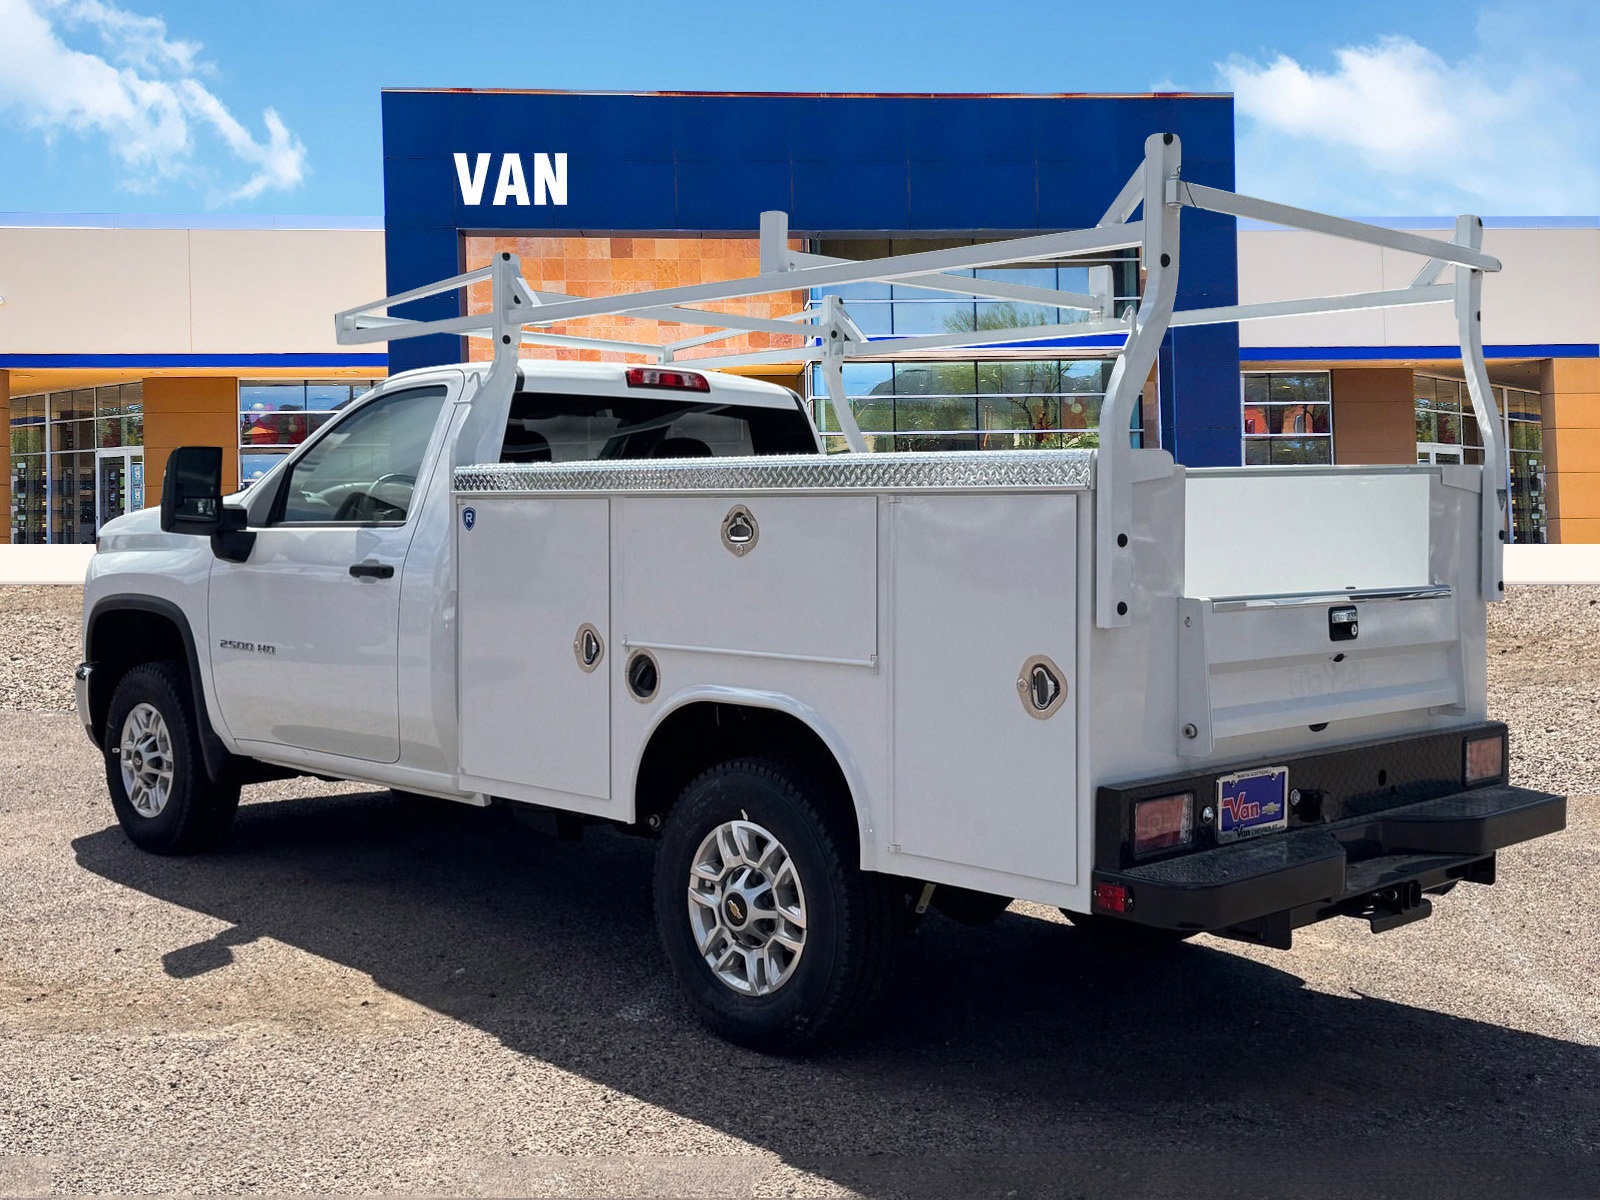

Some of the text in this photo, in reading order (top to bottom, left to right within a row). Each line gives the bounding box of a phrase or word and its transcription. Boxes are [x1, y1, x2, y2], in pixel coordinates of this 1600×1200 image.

[453, 153, 568, 205] VAN
[220, 639, 276, 655] 2500 HD
[1222, 791, 1260, 822] Van
